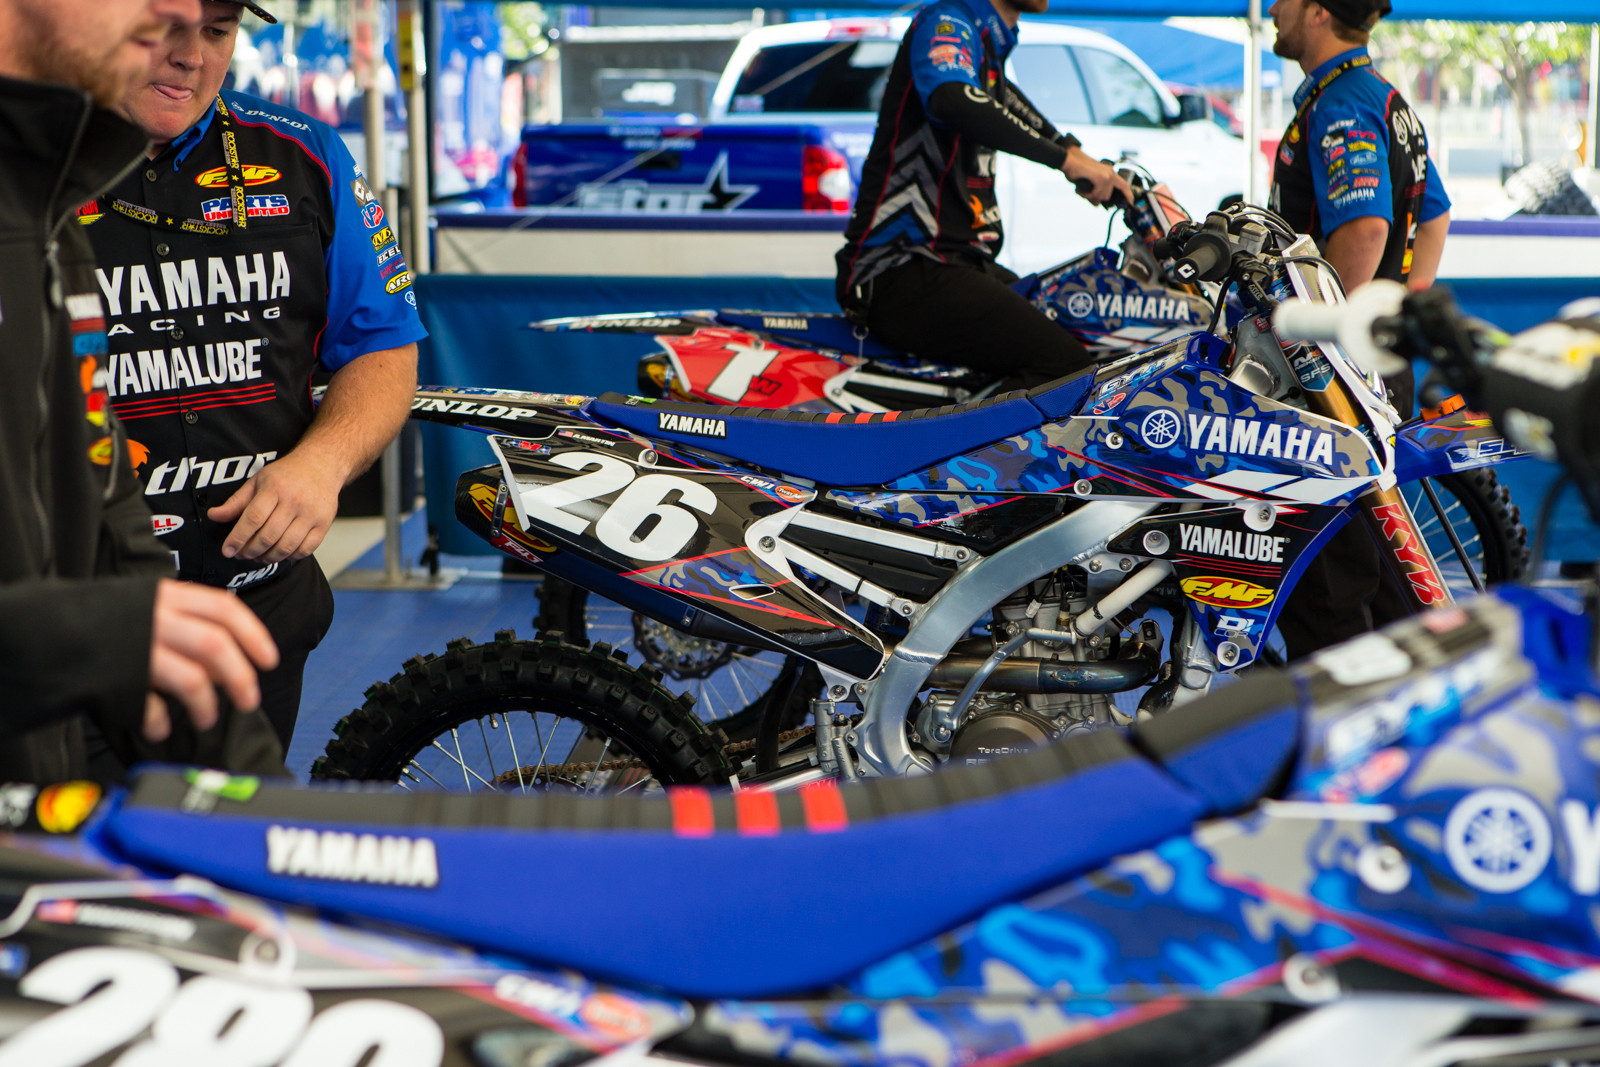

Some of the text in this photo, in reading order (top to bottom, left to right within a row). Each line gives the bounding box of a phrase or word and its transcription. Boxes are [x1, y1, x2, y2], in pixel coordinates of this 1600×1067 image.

[95, 251, 290, 316] YAMAHA
[107, 306, 280, 337] ACING
[763, 316, 808, 330] YAMAHA
[1097, 293, 1190, 321] YAMAHA
[102, 338, 263, 398] YAMALUBE
[705, 343, 780, 403] 1
[1300, 362, 1331, 383] SFS
[411, 396, 538, 421] UNLOP
[659, 412, 726, 438] YAMAHA
[1189, 413, 1335, 466] YAMAHA
[144, 451, 278, 496] thor
[519, 451, 718, 562] 26
[1179, 522, 1284, 563] YAMALUBE
[1371, 503, 1446, 605] KYB
[1181, 578, 1275, 603] FMF
[266, 826, 438, 887] YAMAHA
